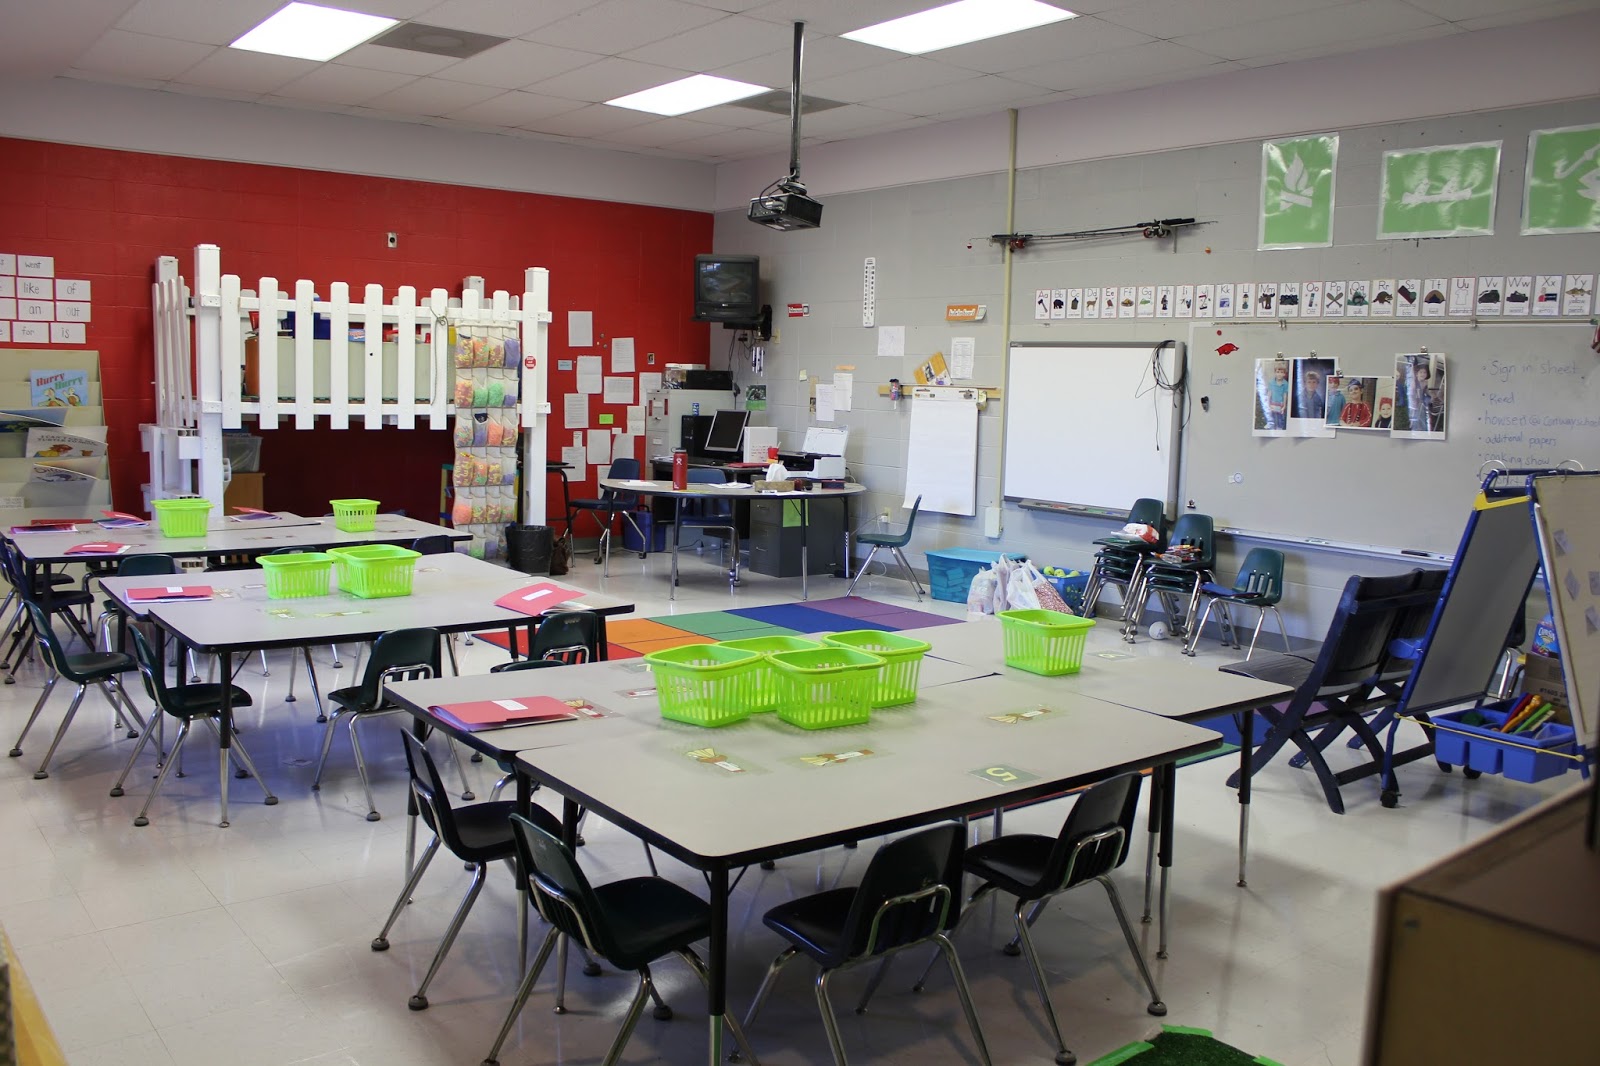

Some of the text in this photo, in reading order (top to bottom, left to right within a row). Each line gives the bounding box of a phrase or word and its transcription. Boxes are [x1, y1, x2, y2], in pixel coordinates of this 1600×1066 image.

[23, 282, 40, 294] like
[66, 282, 77, 295] of
[28, 305, 42, 315] an
[65, 306, 81, 317] out
[21, 326, 35, 336] for
[61, 327, 70, 339] is
[1489, 360, 1516, 382] Sign
[1541, 360, 1580, 375] sheet
[35, 372, 65, 387] Hurry
[54, 376, 84, 390] Hurry
[1525, 455, 1551, 465] show
